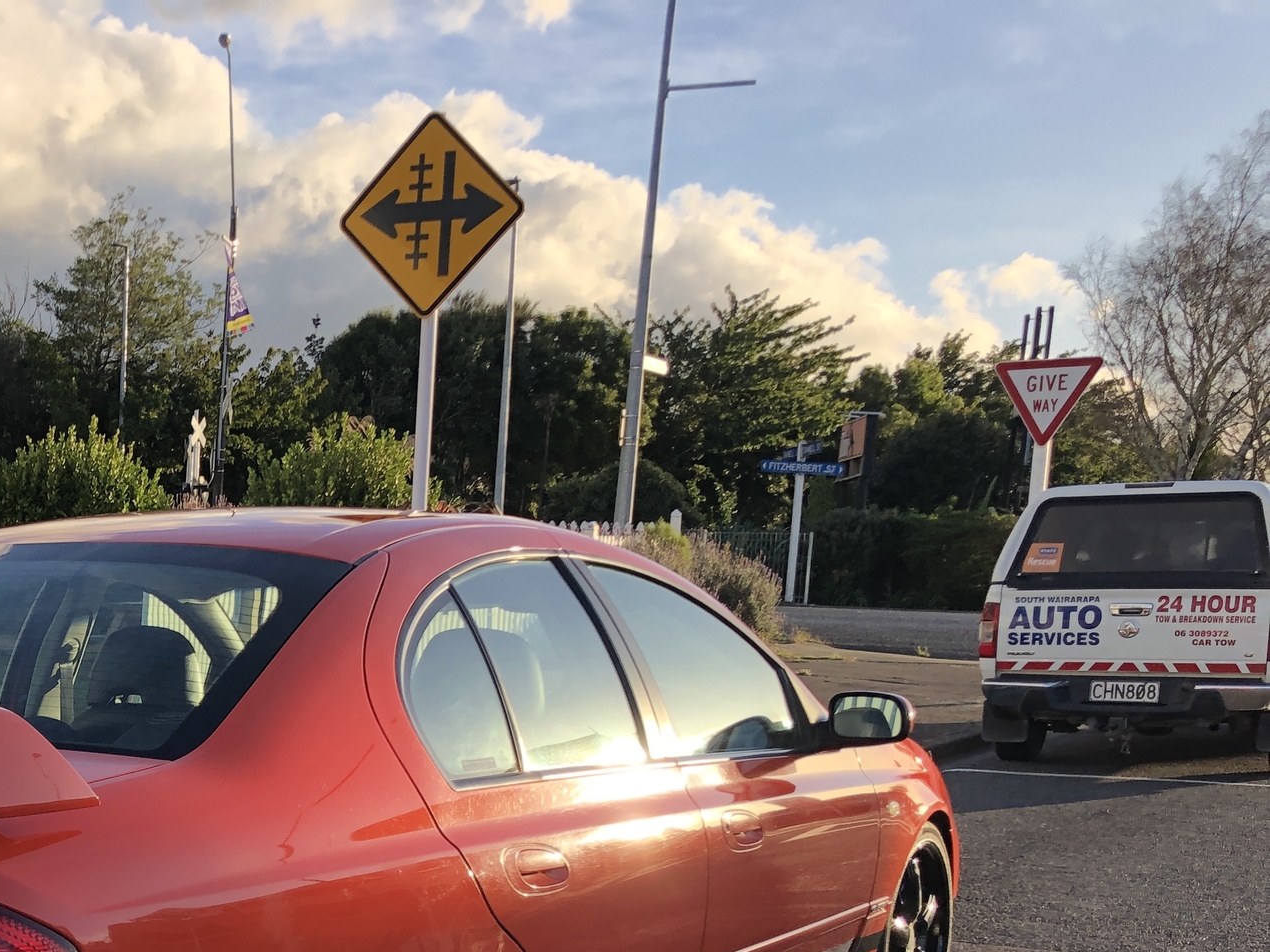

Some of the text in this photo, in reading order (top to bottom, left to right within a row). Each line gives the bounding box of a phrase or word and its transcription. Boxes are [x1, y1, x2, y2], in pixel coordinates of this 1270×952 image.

[1026, 373, 1069, 393] GIVE
[1032, 398, 1059, 413] WAY
[768, 461, 837, 474] FITZHERBERT ST
[1027, 556, 1057, 566] Rescue
[1156, 595, 1257, 613] 24 HOUR
[1008, 605, 1103, 630] AUTO
[1155, 615, 1257, 624] TOW & BREAKDOWN SERVICE
[1007, 632, 1100, 646] SERVICES
[1174, 630, 1230, 638] 06 3089372
[1192, 638, 1237, 647] CAR TOW
[1092, 683, 1157, 700] CHN808
